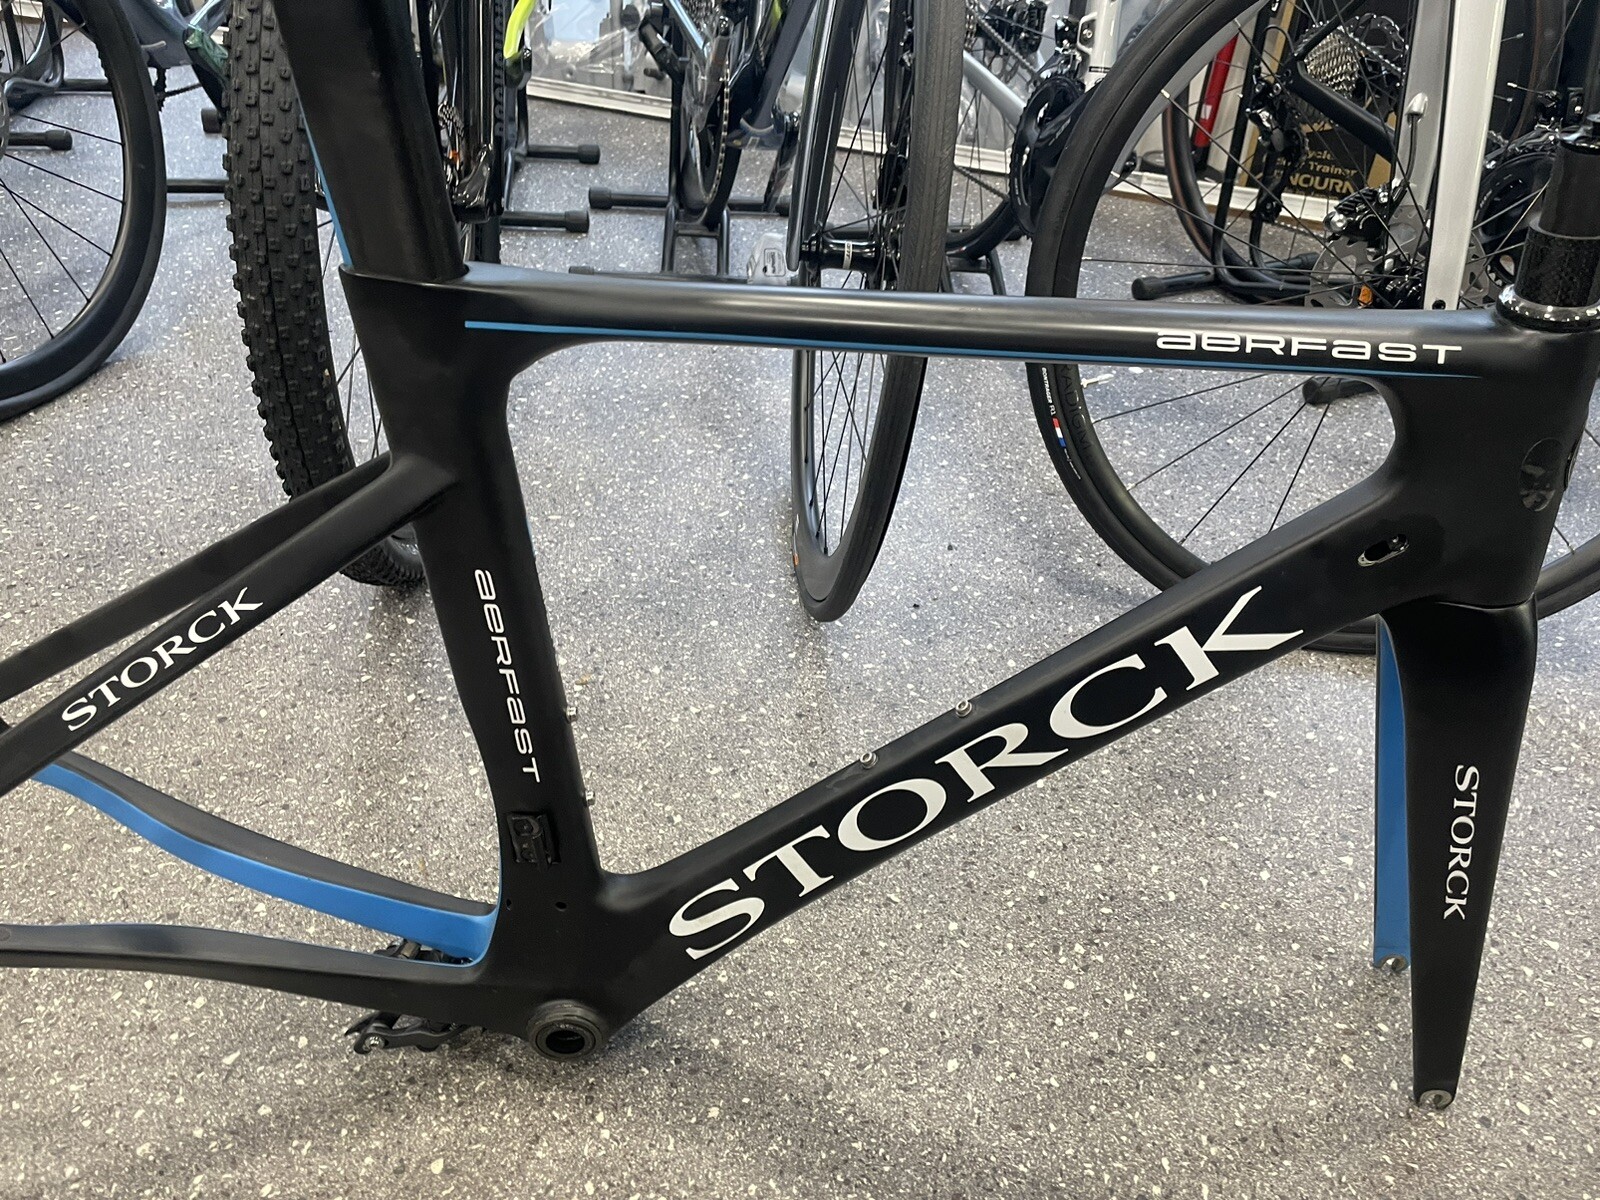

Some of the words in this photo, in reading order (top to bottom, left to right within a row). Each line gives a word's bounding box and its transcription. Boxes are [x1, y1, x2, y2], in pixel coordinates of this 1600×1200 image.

[61, 586, 264, 732] STORCK
[668, 585, 1304, 960] STORCK
[1443, 764, 1480, 920] STORCK
